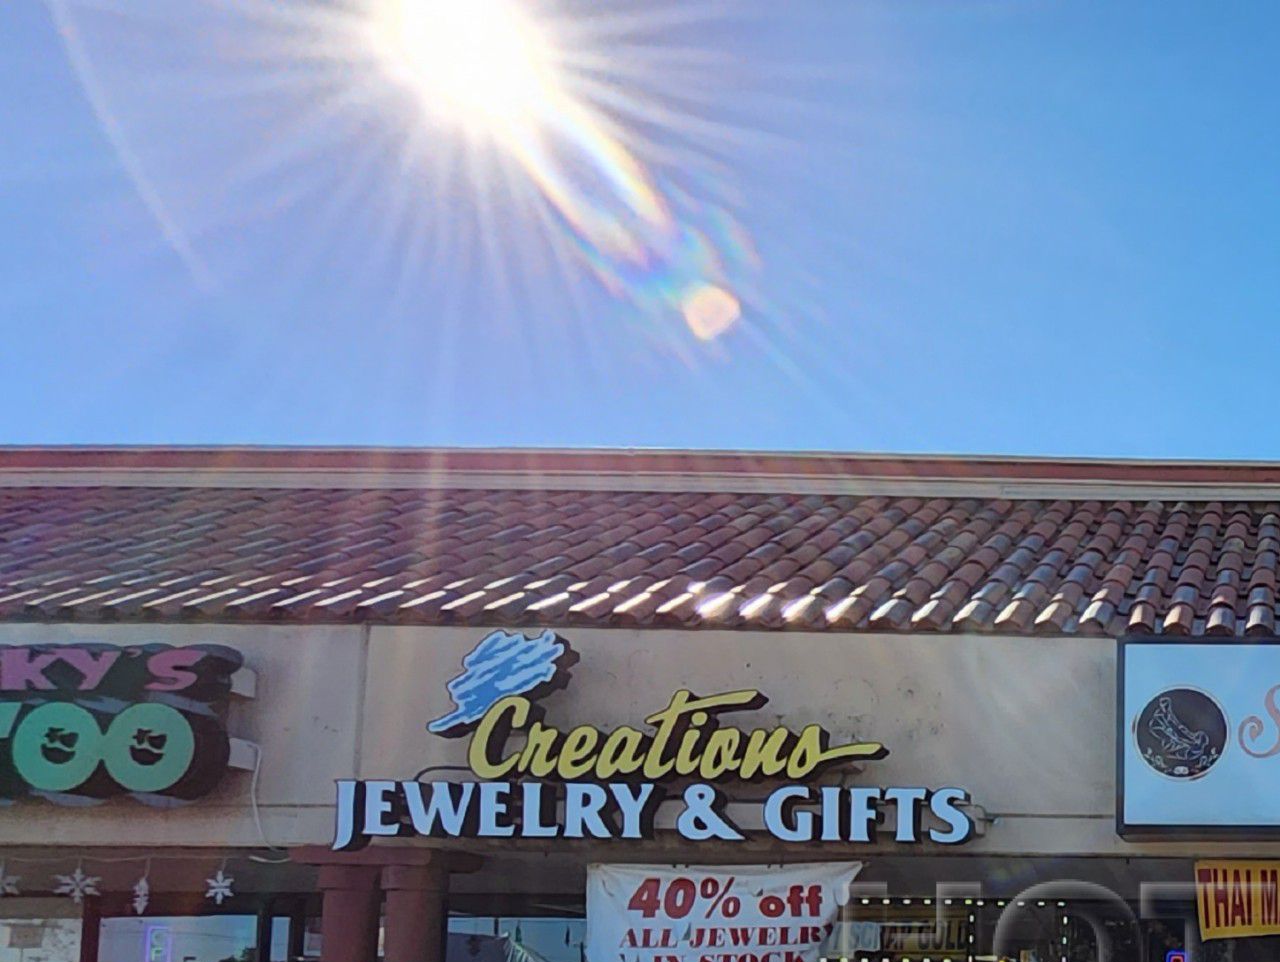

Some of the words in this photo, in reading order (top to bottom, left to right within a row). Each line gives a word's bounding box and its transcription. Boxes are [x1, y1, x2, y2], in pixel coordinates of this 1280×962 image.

[466, 690, 885, 779] Creations
[331, 778, 655, 850] JEWELRY
[676, 782, 745, 840] &
[762, 785, 974, 843] GIFTS
[627, 876, 741, 919] 40%
[758, 884, 823, 917] off
[1198, 868, 1253, 929] THAI
[619, 927, 678, 948] ALL
